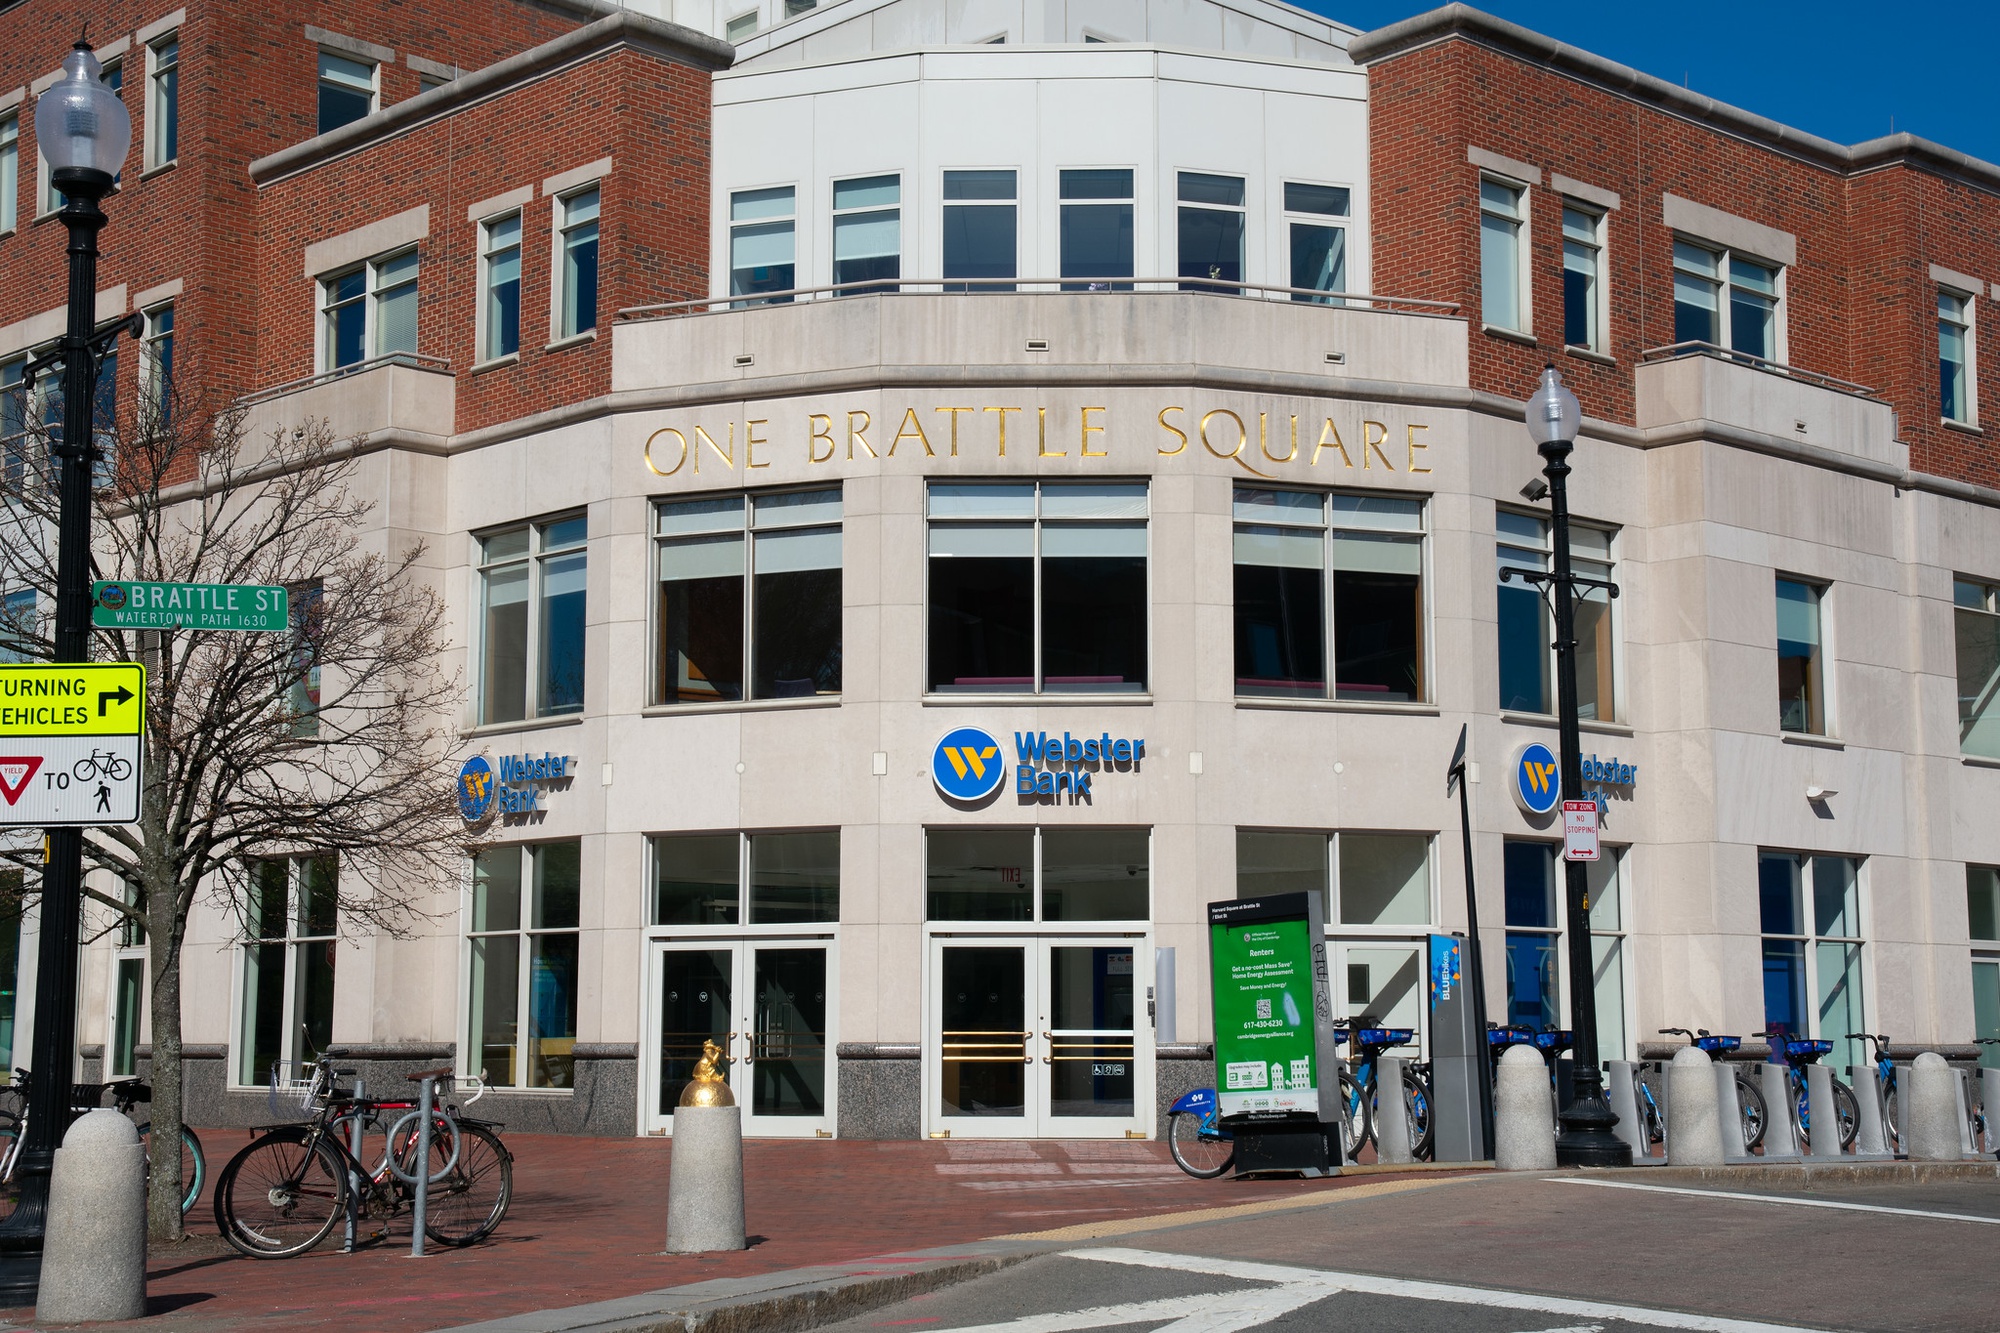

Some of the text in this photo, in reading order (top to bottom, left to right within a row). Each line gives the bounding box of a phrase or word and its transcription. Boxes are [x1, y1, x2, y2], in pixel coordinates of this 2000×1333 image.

[644, 406, 1433, 479] ONE BRATTLE SQUARE
[131, 586, 239, 610] BRATTLE
[255, 589, 282, 611] ST
[115, 611, 267, 627] WATERTOWN PATH 1630
[0, 707, 88, 725] EHICLES
[1015, 731, 1144, 762] Webster
[499, 752, 570, 783] Webster
[1016, 765, 1090, 794] Bank
[1579, 753, 1637, 785] ebster
[44, 773, 69, 789] TO
[499, 783, 539, 813] Bank
[1566, 803, 1594, 811] TOW ZONE
[1582, 787, 1609, 813] ank
[1567, 826, 1595, 834] STOPPING
[1249, 949, 1274, 957] Renters
[1264, 969, 1294, 977] Assessment
[1442, 950, 1450, 1001] BLUEbikes
[1243, 1019, 1283, 1029] 617-430-6230
